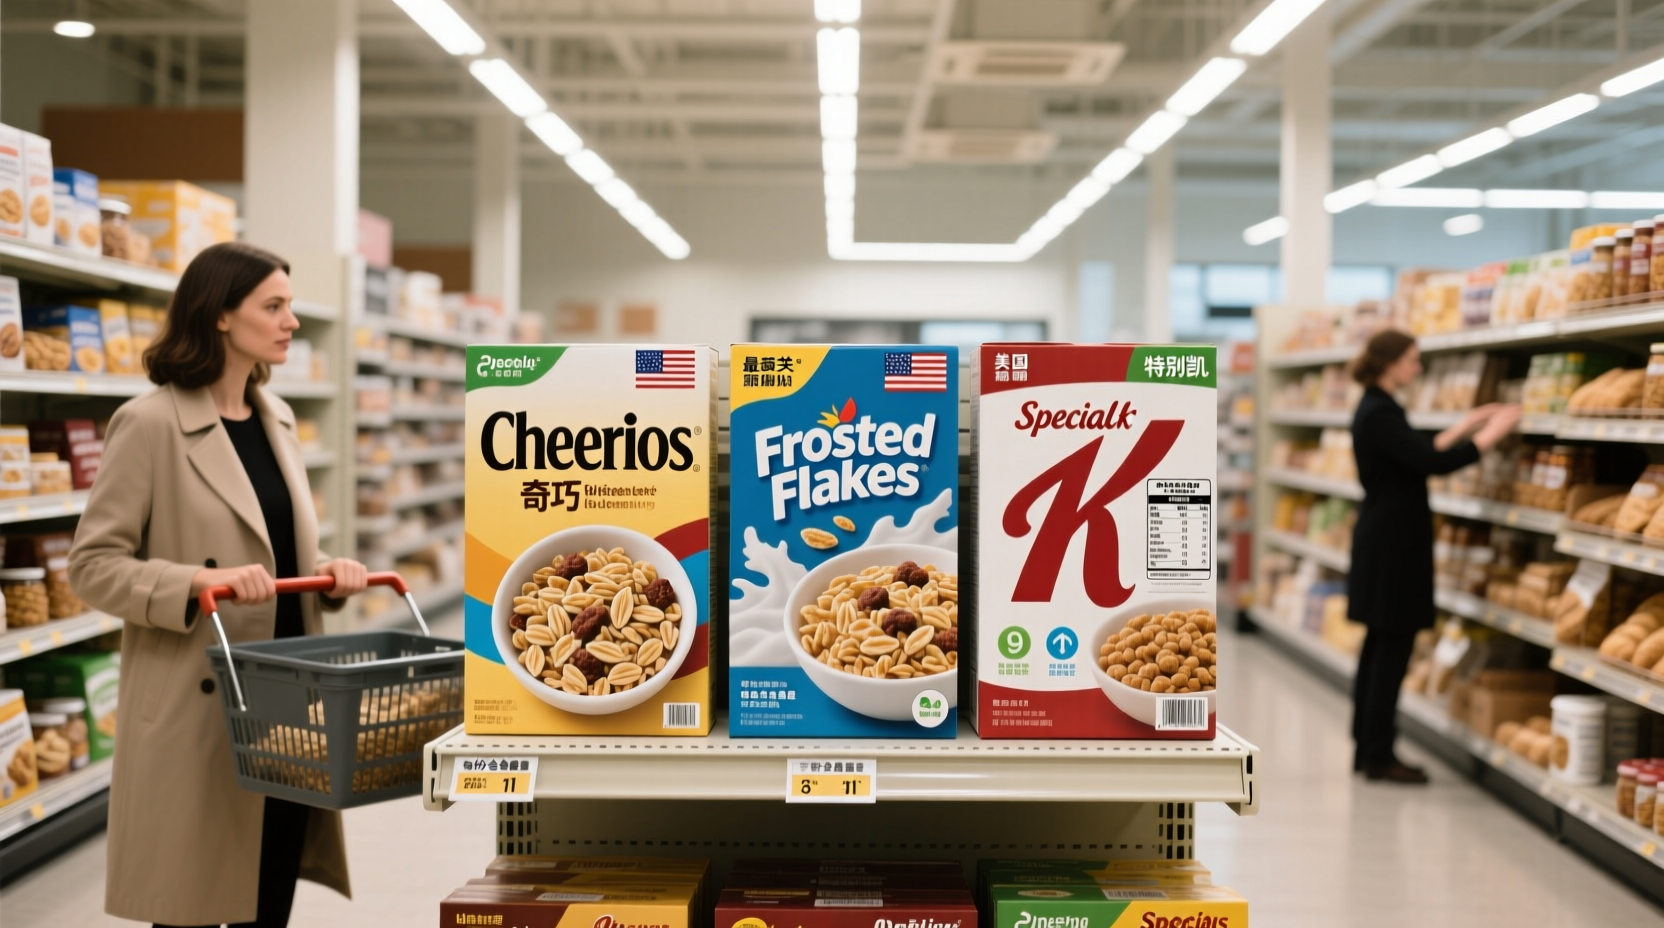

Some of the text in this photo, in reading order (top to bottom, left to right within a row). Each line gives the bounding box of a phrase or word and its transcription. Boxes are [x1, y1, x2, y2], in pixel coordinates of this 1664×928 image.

[1144, 355, 1209, 378] 特别凯
[481, 411, 693, 471] Cheerios
[755, 413, 936, 478] Frosted
[520, 479, 582, 512] 奇巧
[771, 459, 920, 521] Flakes
[1002, 420, 1185, 608] K
[1006, 631, 1023, 654] 9
